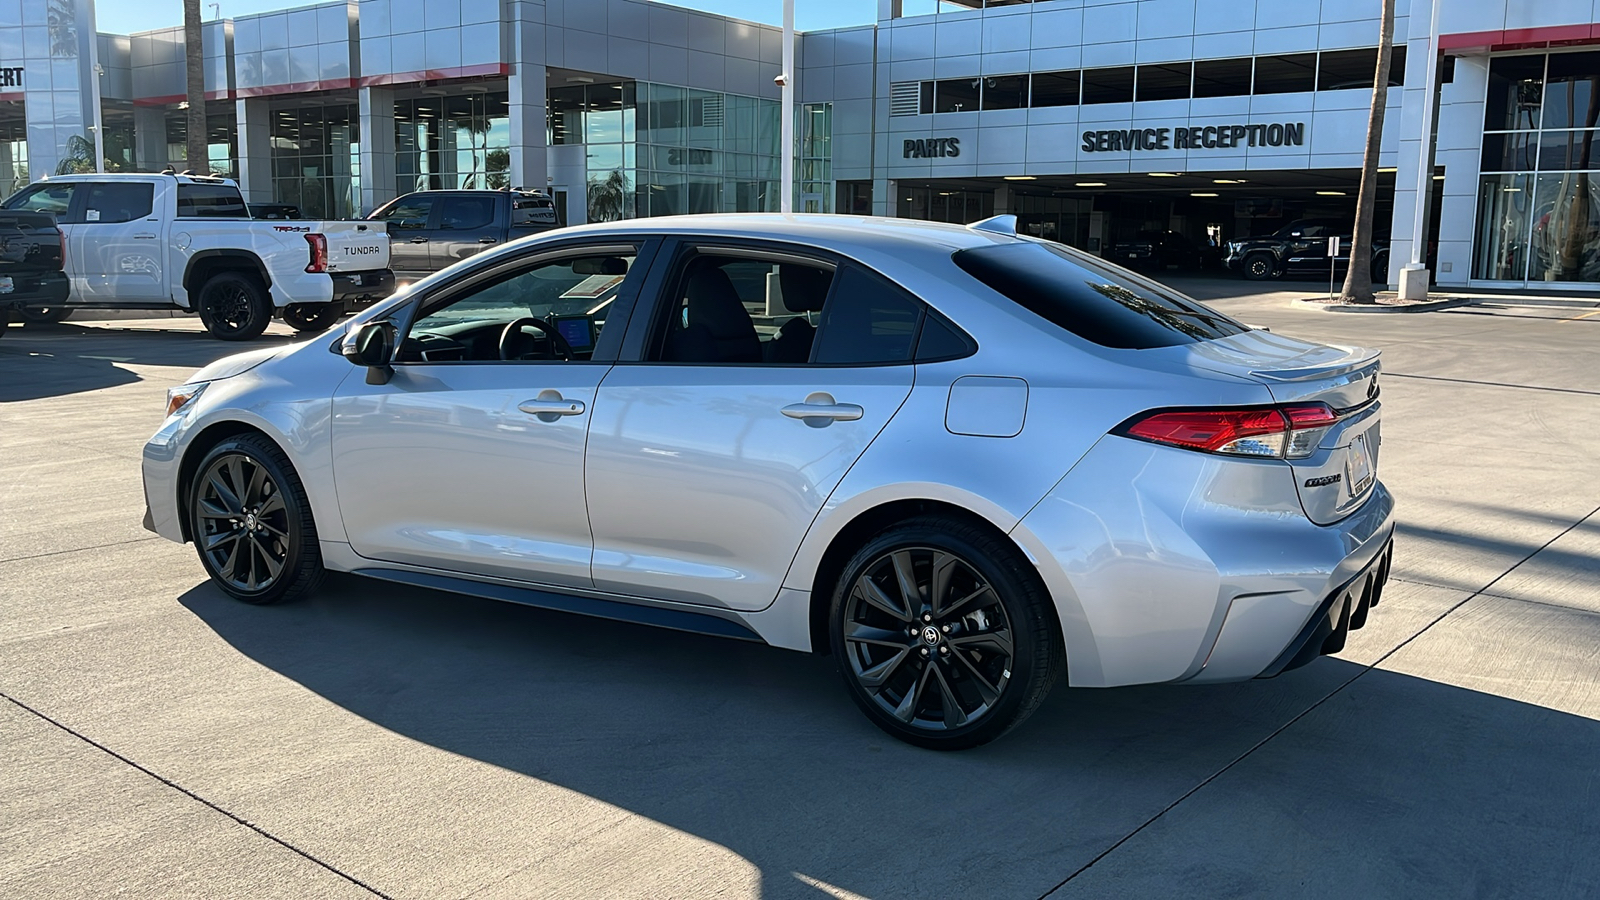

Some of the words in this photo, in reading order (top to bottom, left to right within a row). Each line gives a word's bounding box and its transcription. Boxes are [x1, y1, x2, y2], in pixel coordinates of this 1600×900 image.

[903, 137, 960, 159] PARTS
[1081, 127, 1170, 152] SERVICE
[1173, 122, 1304, 149] RECEPTION
[343, 245, 380, 256] TUNDRA
